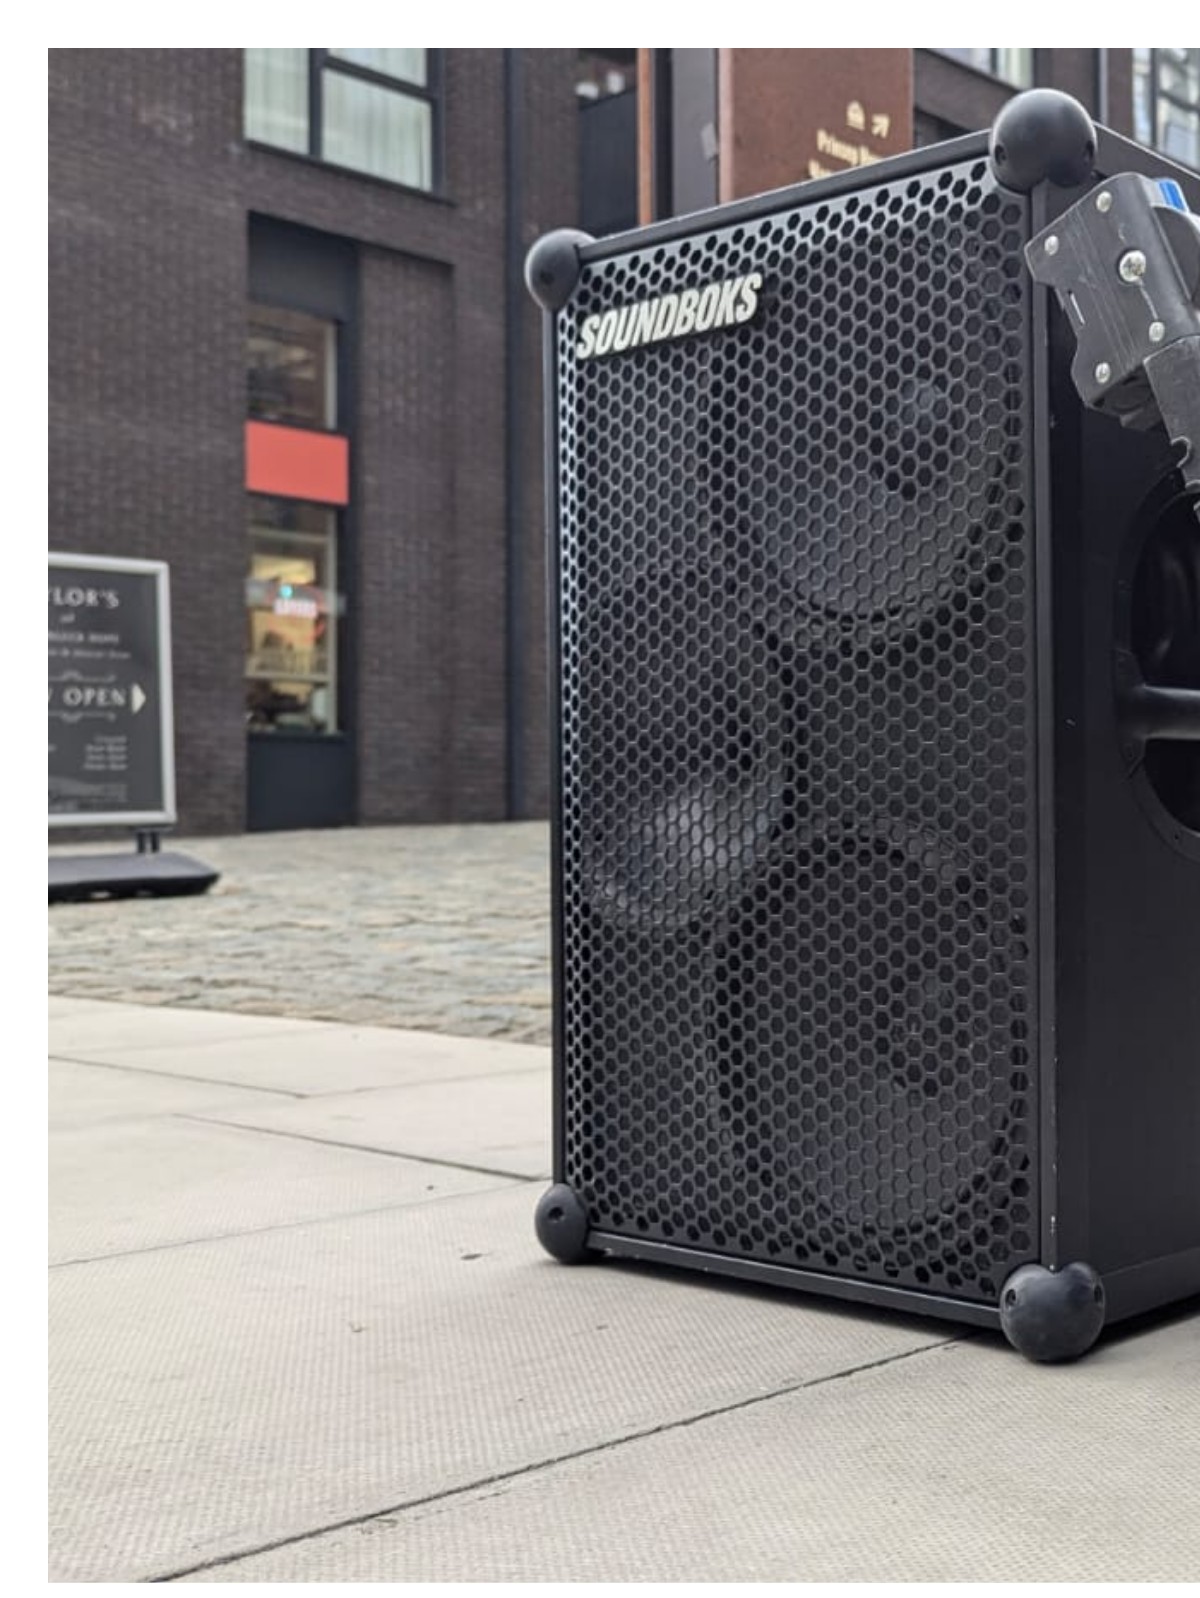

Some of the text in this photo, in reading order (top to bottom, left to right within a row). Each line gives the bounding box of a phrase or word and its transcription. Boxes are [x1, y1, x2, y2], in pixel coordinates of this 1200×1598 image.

[576, 272, 763, 360] SOUNDBOKS
[48, 586, 120, 609] LOR'S
[62, 686, 126, 707] OPEN
